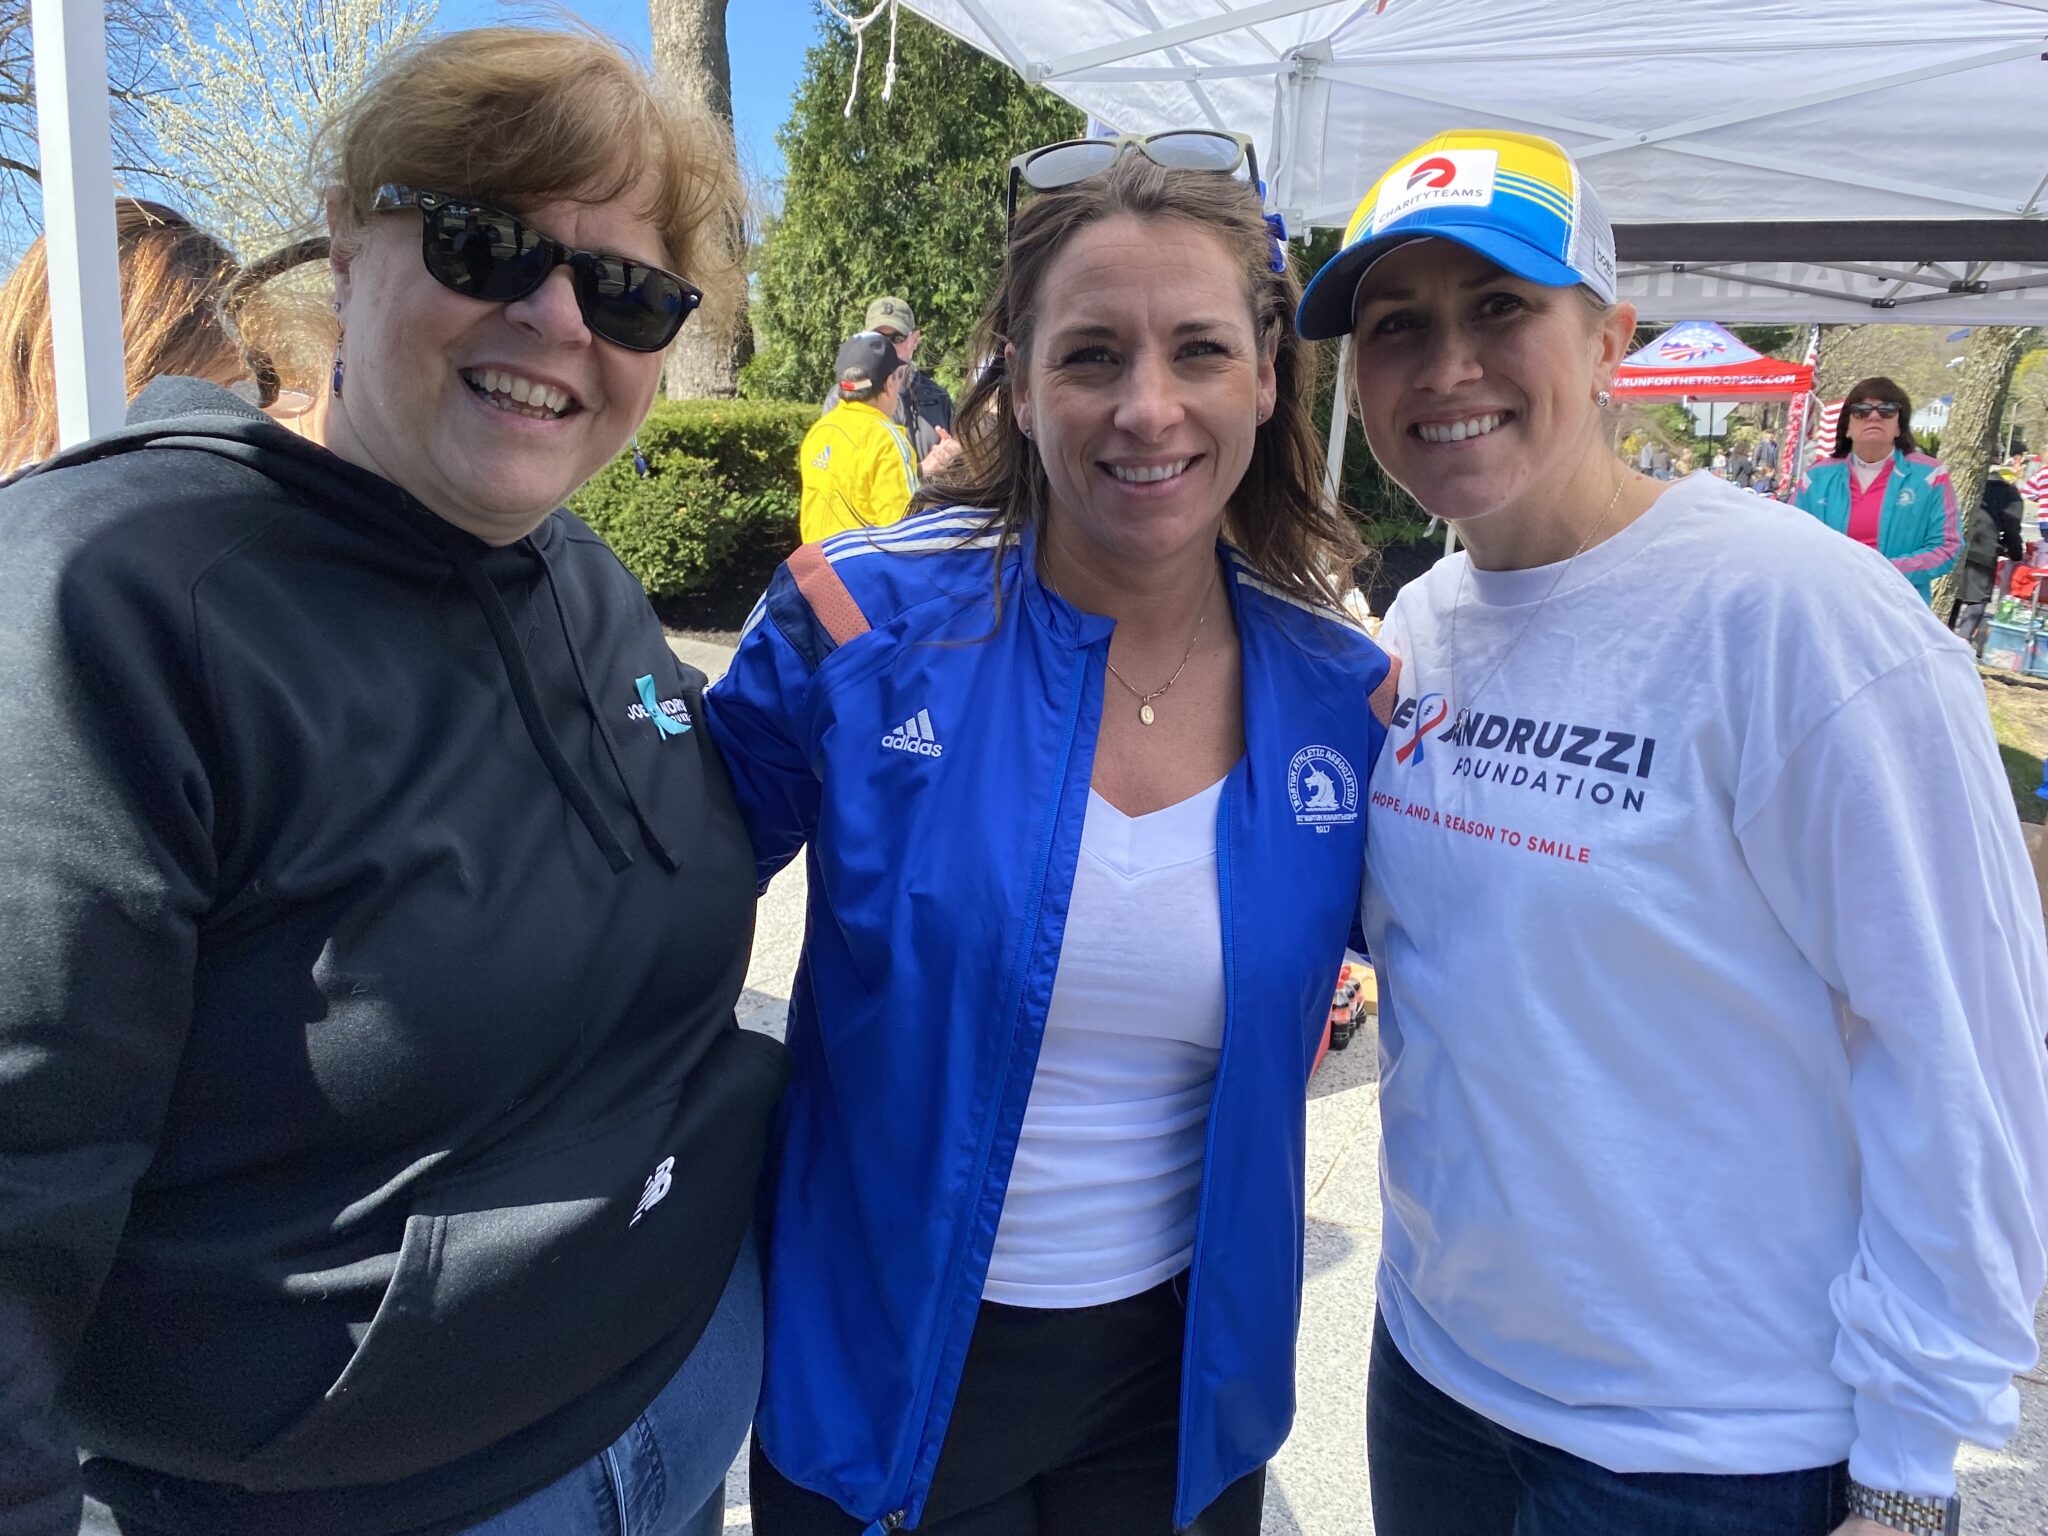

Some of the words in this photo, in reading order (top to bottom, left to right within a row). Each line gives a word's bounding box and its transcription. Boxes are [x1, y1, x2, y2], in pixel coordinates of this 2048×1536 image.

[1378, 187, 1484, 224] CHARITYTEAMS
[881, 734, 943, 758] adidas
[1293, 748, 1325, 769] ATHLETIC
[1437, 707, 1656, 779] ANDRUZZI
[1452, 757, 1645, 812] FOUNDATION
[1371, 790, 1402, 815] HOPE,
[1404, 803, 1430, 821] AND
[1432, 811, 1441, 826] A
[1445, 814, 1494, 841] REASON
[1500, 828, 1521, 847] TO
[1527, 836, 1591, 864] SMILE
